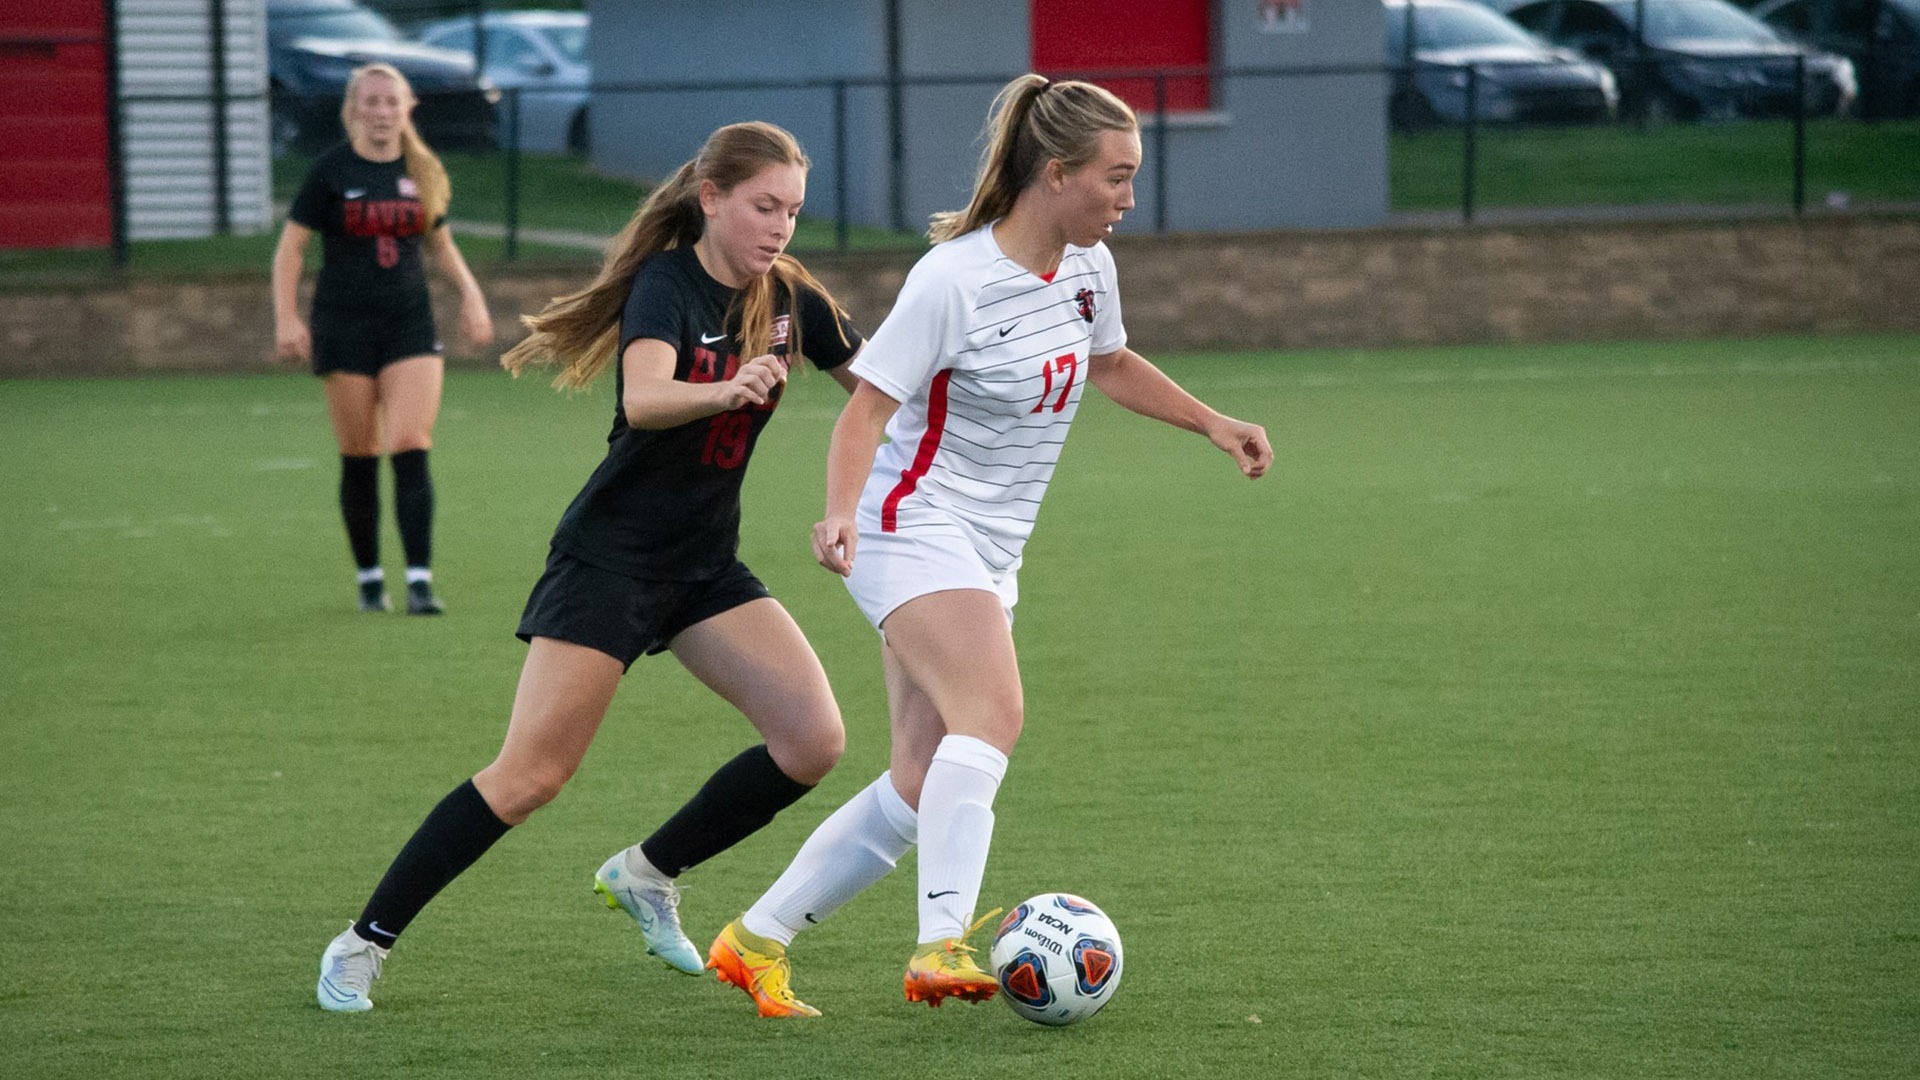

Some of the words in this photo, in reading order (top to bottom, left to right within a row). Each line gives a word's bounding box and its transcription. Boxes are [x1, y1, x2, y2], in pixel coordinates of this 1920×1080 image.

[1030, 352, 1077, 414] 17
[702, 411, 752, 469] 19
[1024, 927, 1063, 956] Wilson
[1038, 912, 1073, 935] NCAA
